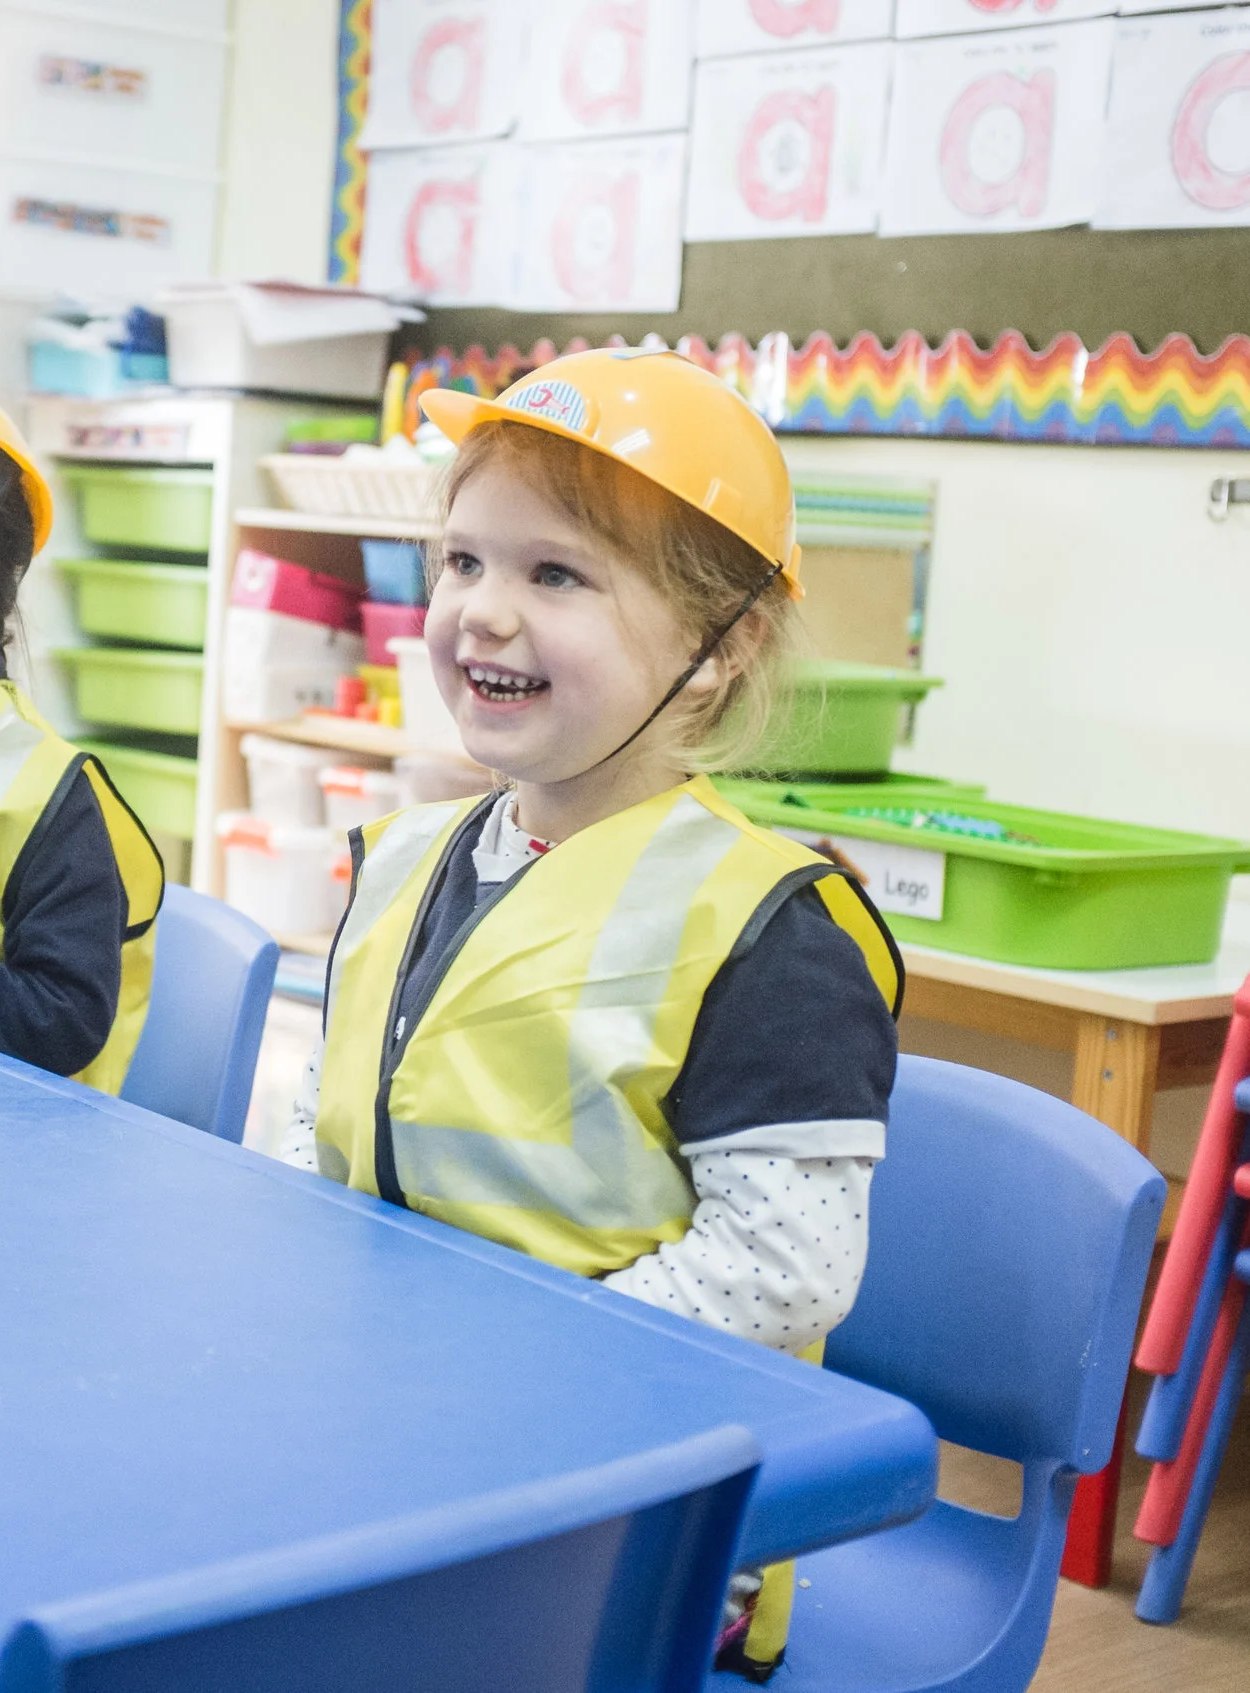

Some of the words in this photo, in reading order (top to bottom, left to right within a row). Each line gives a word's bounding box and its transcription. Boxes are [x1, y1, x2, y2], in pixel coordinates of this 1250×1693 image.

[410, 15, 486, 133] a
[561, 0, 648, 127] a
[736, 83, 836, 223] a
[937, 66, 1056, 218] a
[403, 176, 478, 298] a
[551, 170, 641, 304] a
[884, 868, 930, 907] Lego
